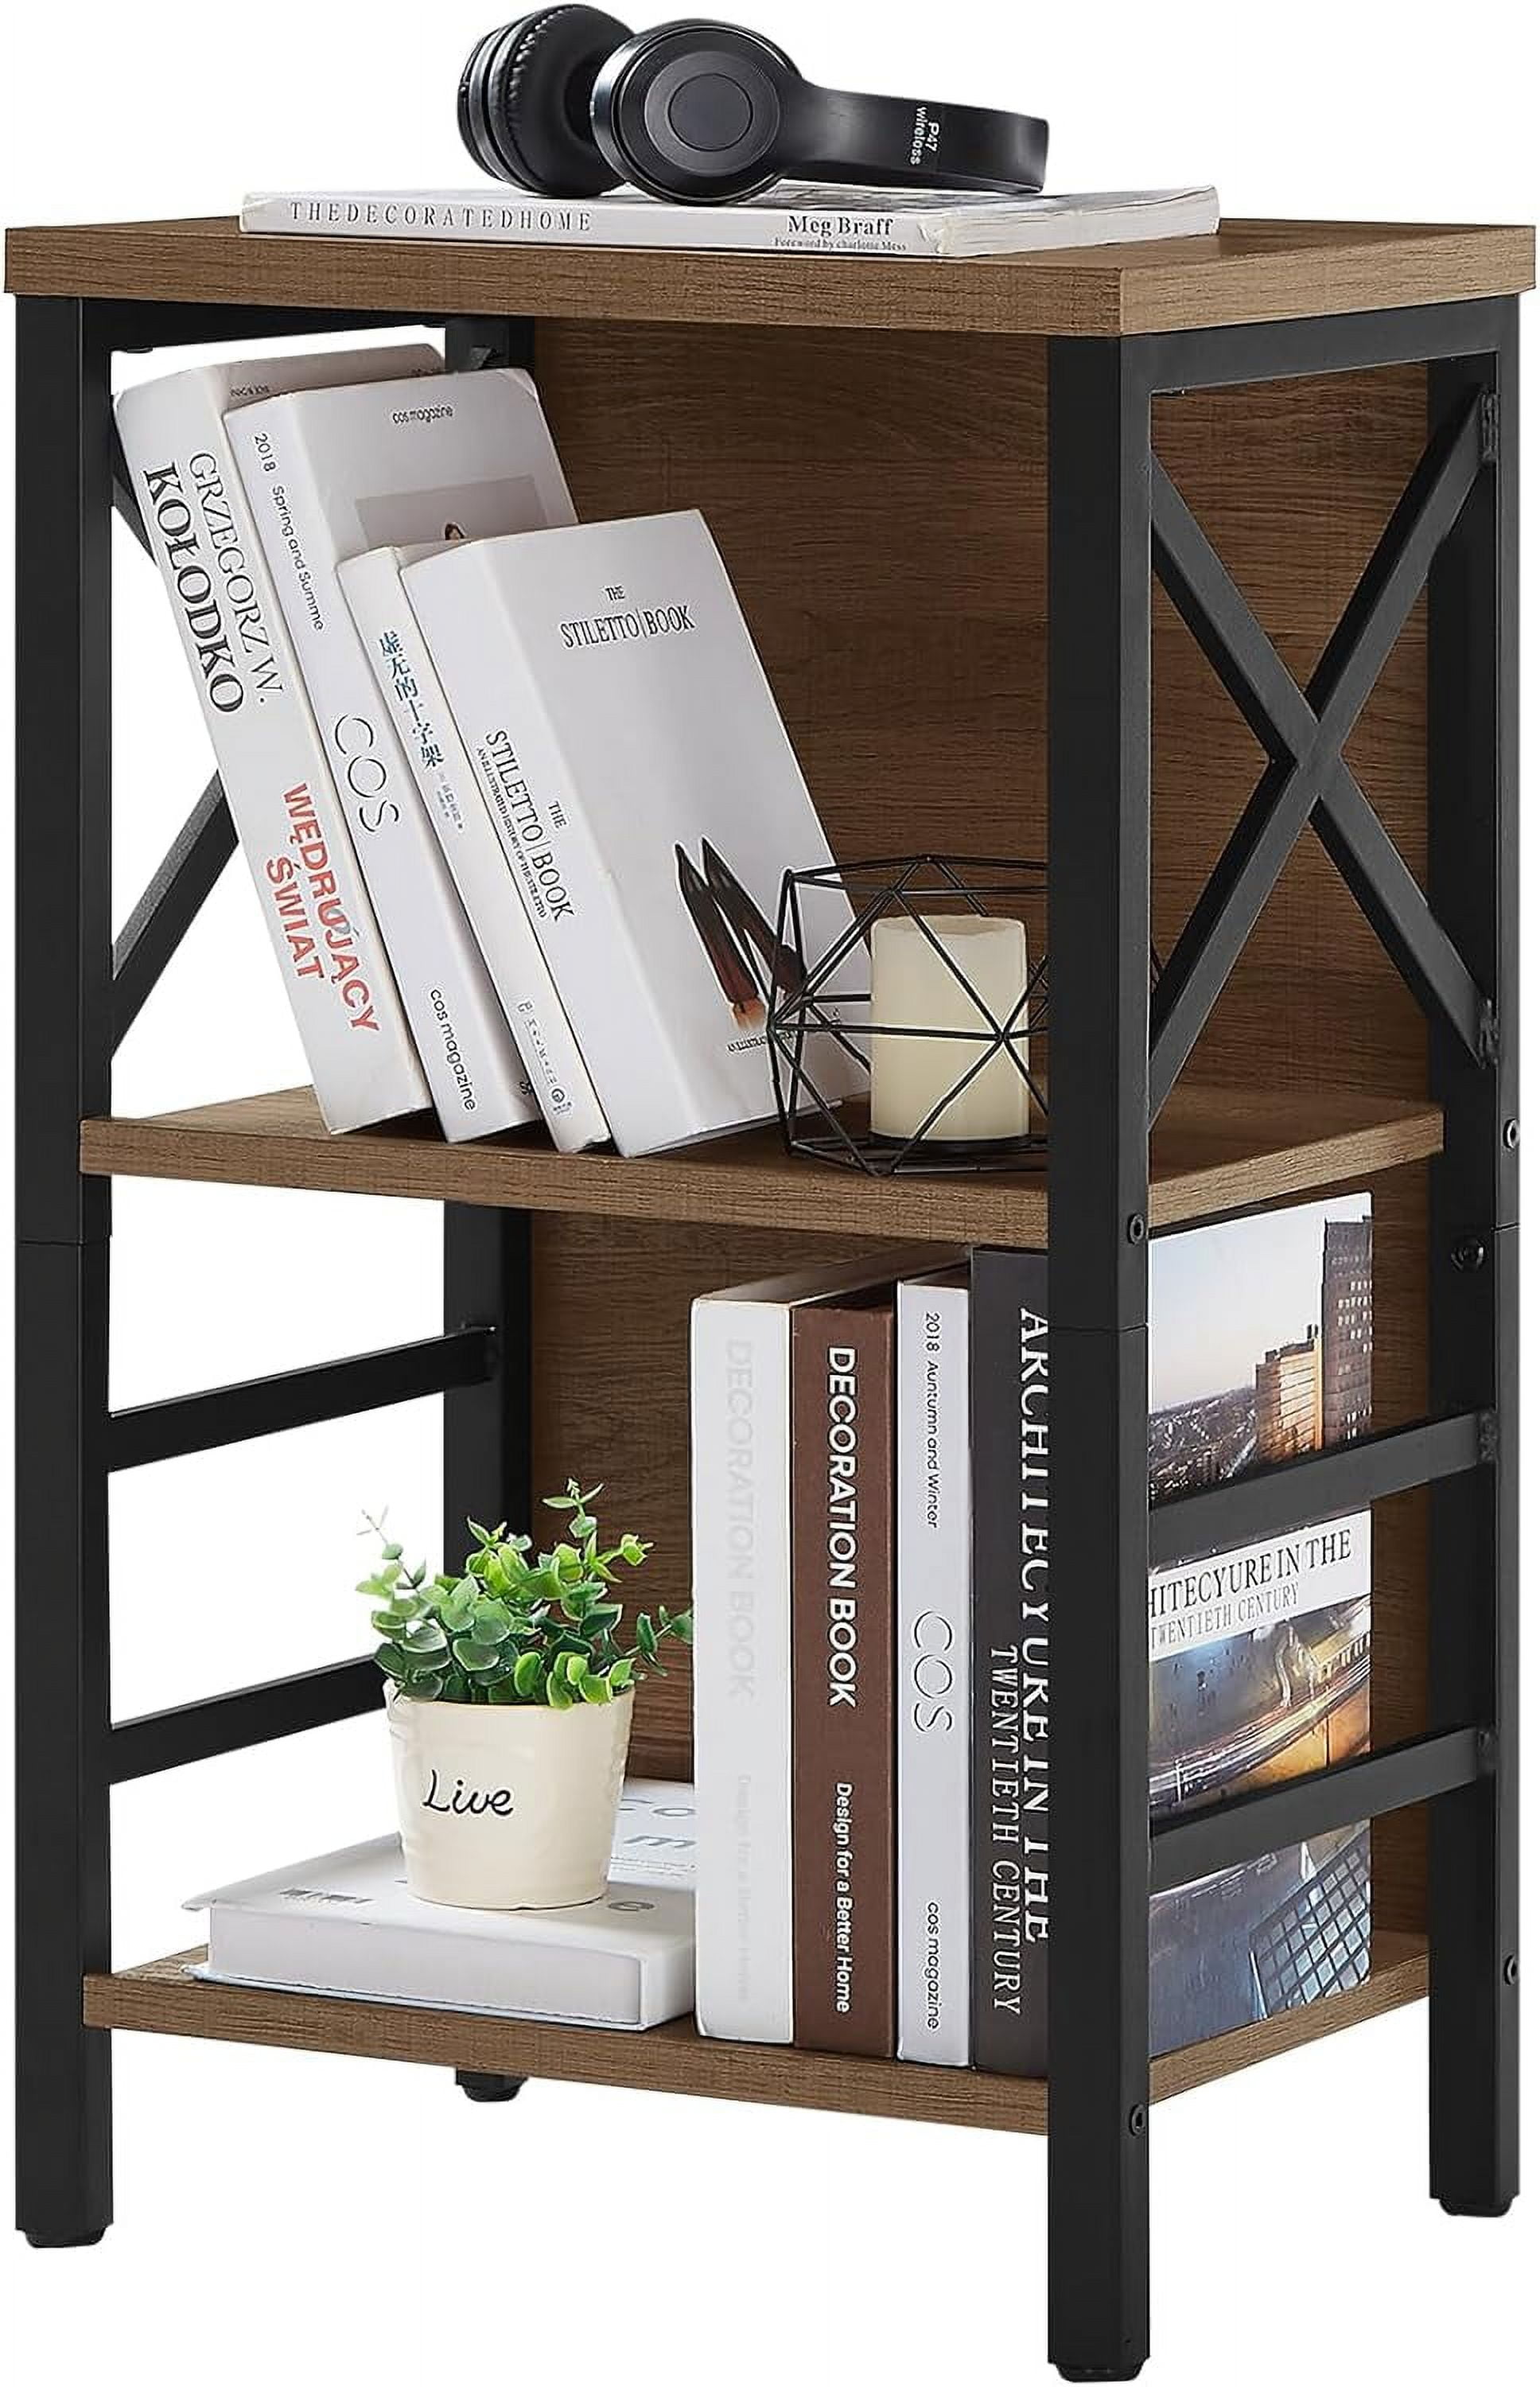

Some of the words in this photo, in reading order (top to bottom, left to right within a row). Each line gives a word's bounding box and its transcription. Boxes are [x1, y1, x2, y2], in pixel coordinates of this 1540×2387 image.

[910, 107, 928, 165] wireless
[925, 122, 939, 151] P47
[788, 216, 831, 237] Meg
[838, 217, 893, 236] Braff
[254, 432, 277, 473] 2018
[272, 485, 294, 538] Spring
[287, 538, 307, 570] and
[143, 461, 245, 714] KOŁODKO
[188, 452, 270, 653] GRZEGORZ
[251, 656, 283, 703] W.
[605, 586, 626, 602] THE
[561, 613, 639, 649] STILETTO
[644, 606, 695, 635] BOOK
[334, 715, 400, 833] COS
[485, 730, 543, 842] STILETTO
[531, 851, 575, 922] BOOK
[548, 800, 567, 828] THE
[264, 855, 325, 979] ŚWIAT
[283, 782, 380, 1033] WĘDRUJĄCY
[430, 989, 449, 1021] cos
[436, 1022, 476, 1112] magazine
[925, 1312, 941, 1352] 2018
[927, 1361, 942, 1435] Auntumn
[725, 1341, 755, 1579] DECORATION
[827, 1347, 856, 1591] DECORATION
[926, 1437, 942, 1470] and
[927, 1471, 942, 1528] Winter
[1277, 1545, 1300, 1579] IN
[1305, 1528, 1351, 1568] THE
[1238, 1582, 1299, 1622] CENTURY
[725, 1591, 755, 1702] BOOK
[827, 1597, 856, 1708] BOOK
[913, 1610, 952, 1732] COS
[990, 1645, 1018, 1841] TWENTIETH
[422, 1769, 515, 1818] Live
[834, 1782, 852, 1844] Design
[1023, 1755, 1049, 1814] IN
[836, 1848, 852, 1877] for
[838, 1880, 850, 1893] a
[836, 1895, 852, 1955] Better
[928, 1902, 939, 1935] cos
[992, 1862, 1020, 2015] CENTURY
[836, 1957, 851, 2013] Home
[924, 1938, 939, 2030] magazine
